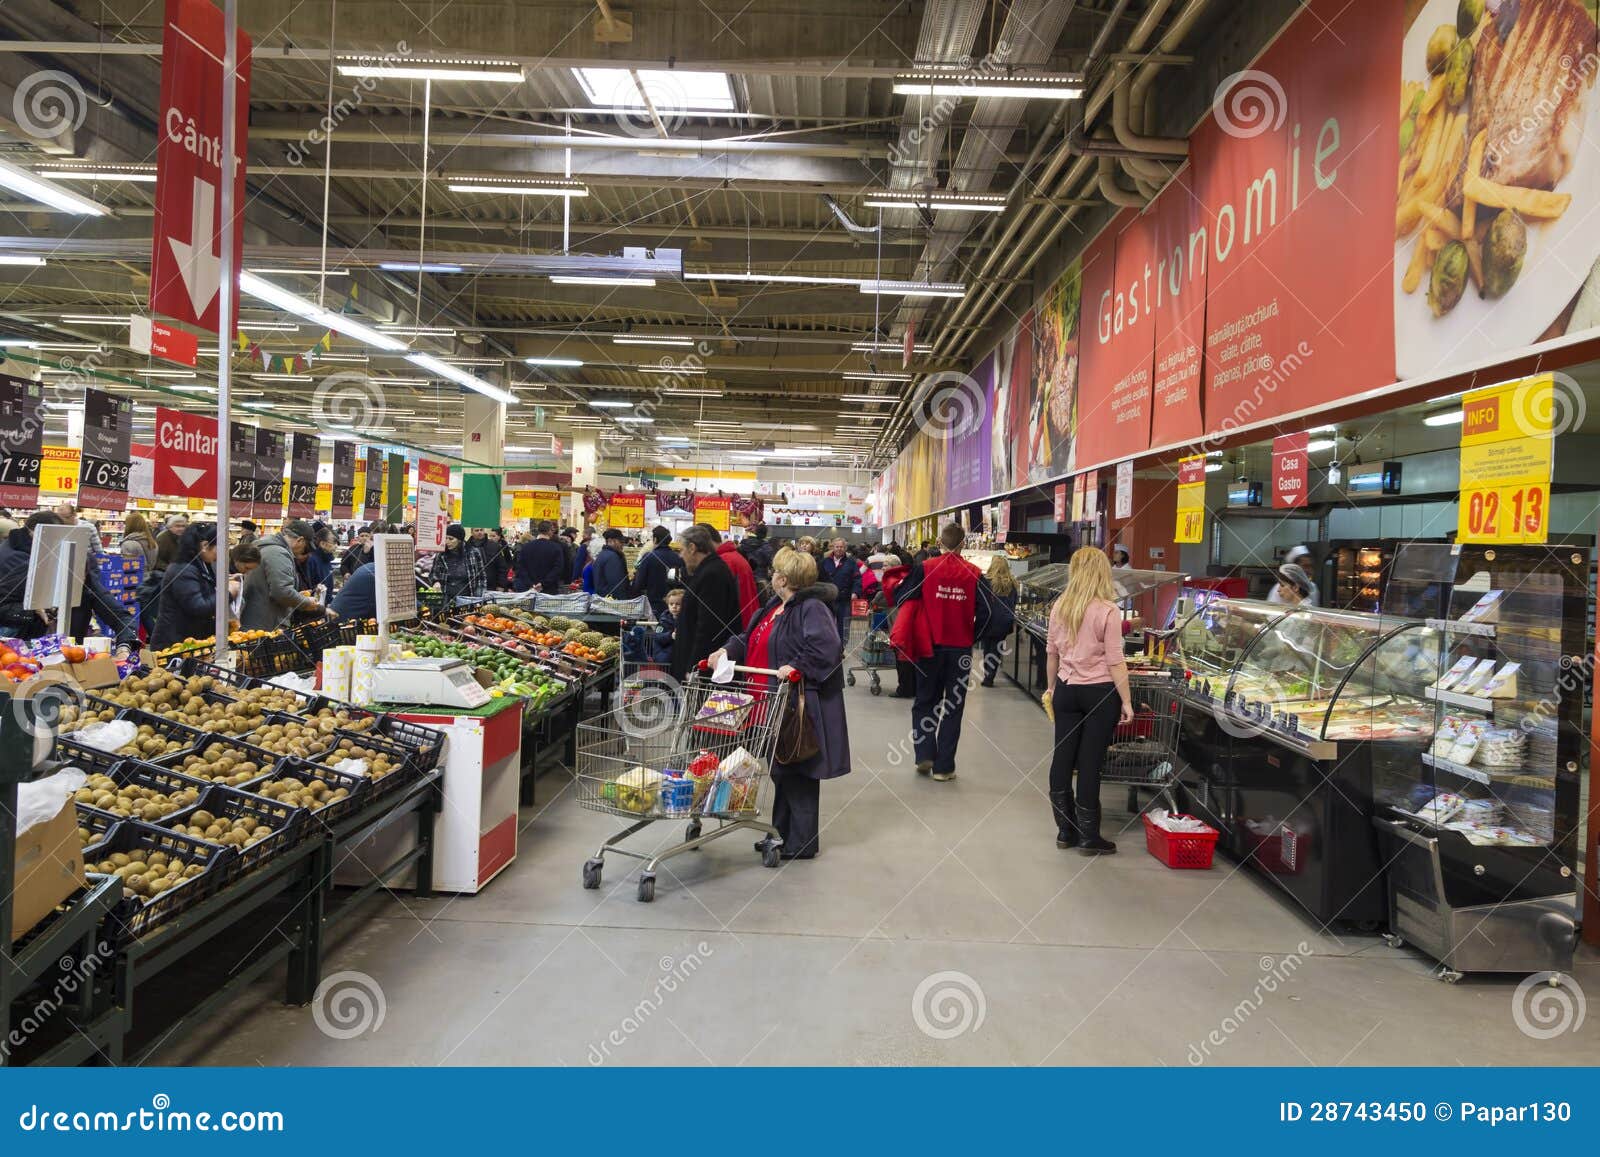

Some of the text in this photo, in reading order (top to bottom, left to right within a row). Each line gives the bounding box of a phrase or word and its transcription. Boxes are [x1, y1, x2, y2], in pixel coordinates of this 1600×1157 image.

[166, 107, 242, 178] Cântr
[1098, 117, 1341, 344] Gastronomie
[1467, 407, 1495, 427] INFO
[160, 421, 219, 456] Cântar
[1281, 457, 1299, 471] Casa
[1278, 476, 1302, 491] Gastro
[1468, 487, 1543, 535] 02 13
